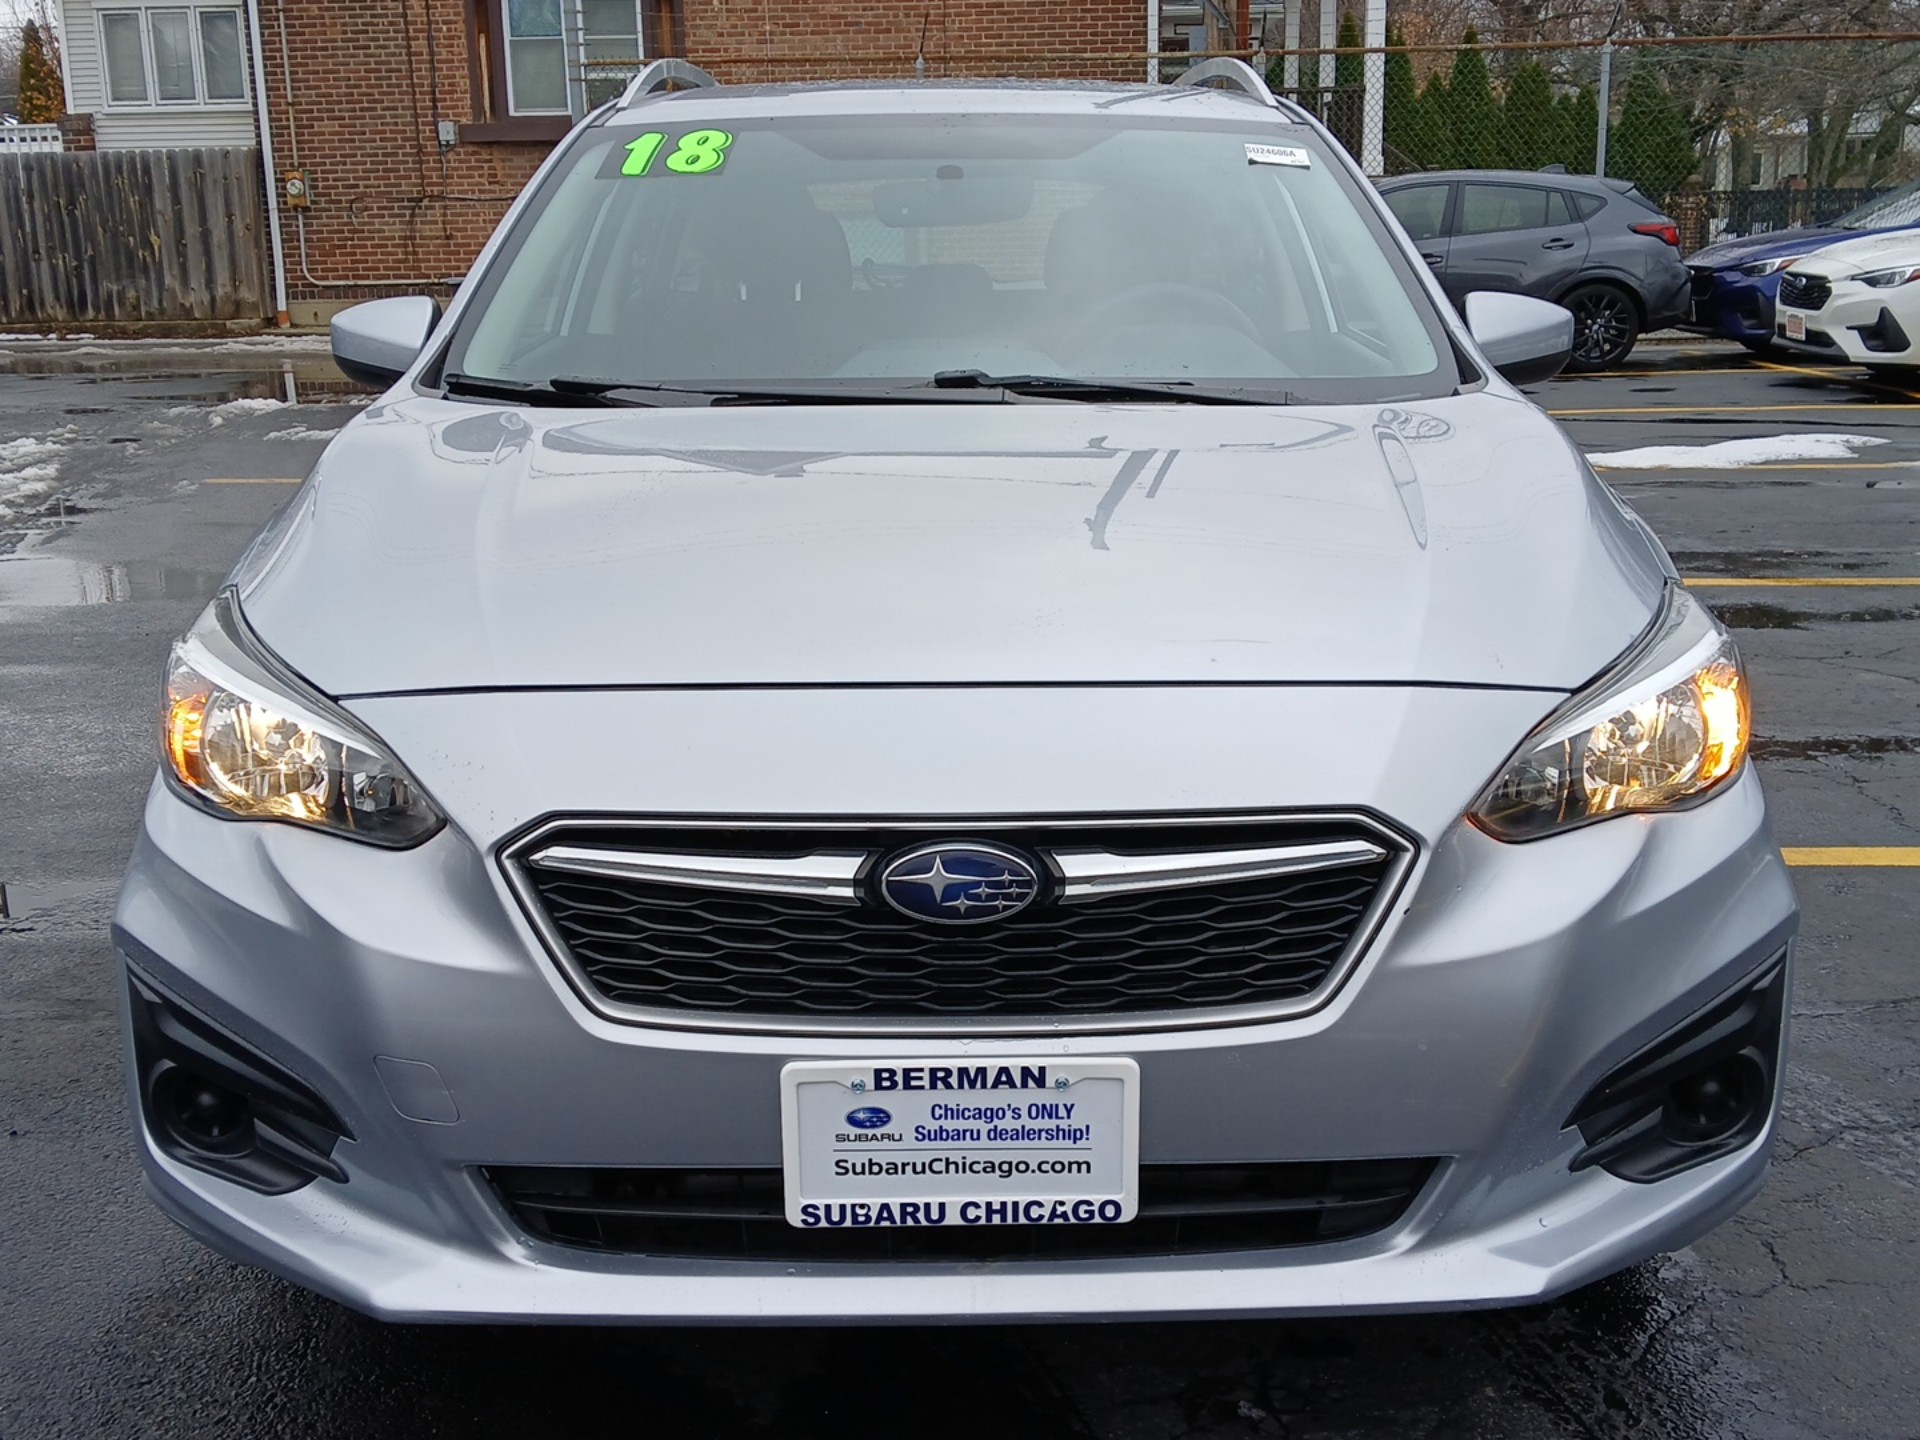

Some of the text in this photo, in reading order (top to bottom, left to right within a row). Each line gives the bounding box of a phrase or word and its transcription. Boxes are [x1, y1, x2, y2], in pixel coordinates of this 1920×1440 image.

[620, 128, 734, 176] 18
[873, 1066, 1047, 1091] BERMAN
[930, 1103, 1076, 1123] Chicago's ONLY
[835, 1133, 903, 1142] SUBARU
[914, 1124, 1091, 1144] Subaru dealership!
[834, 1157, 1092, 1178] SubaruChicago.com
[800, 1200, 1123, 1227] SUBARU CHICAGO
